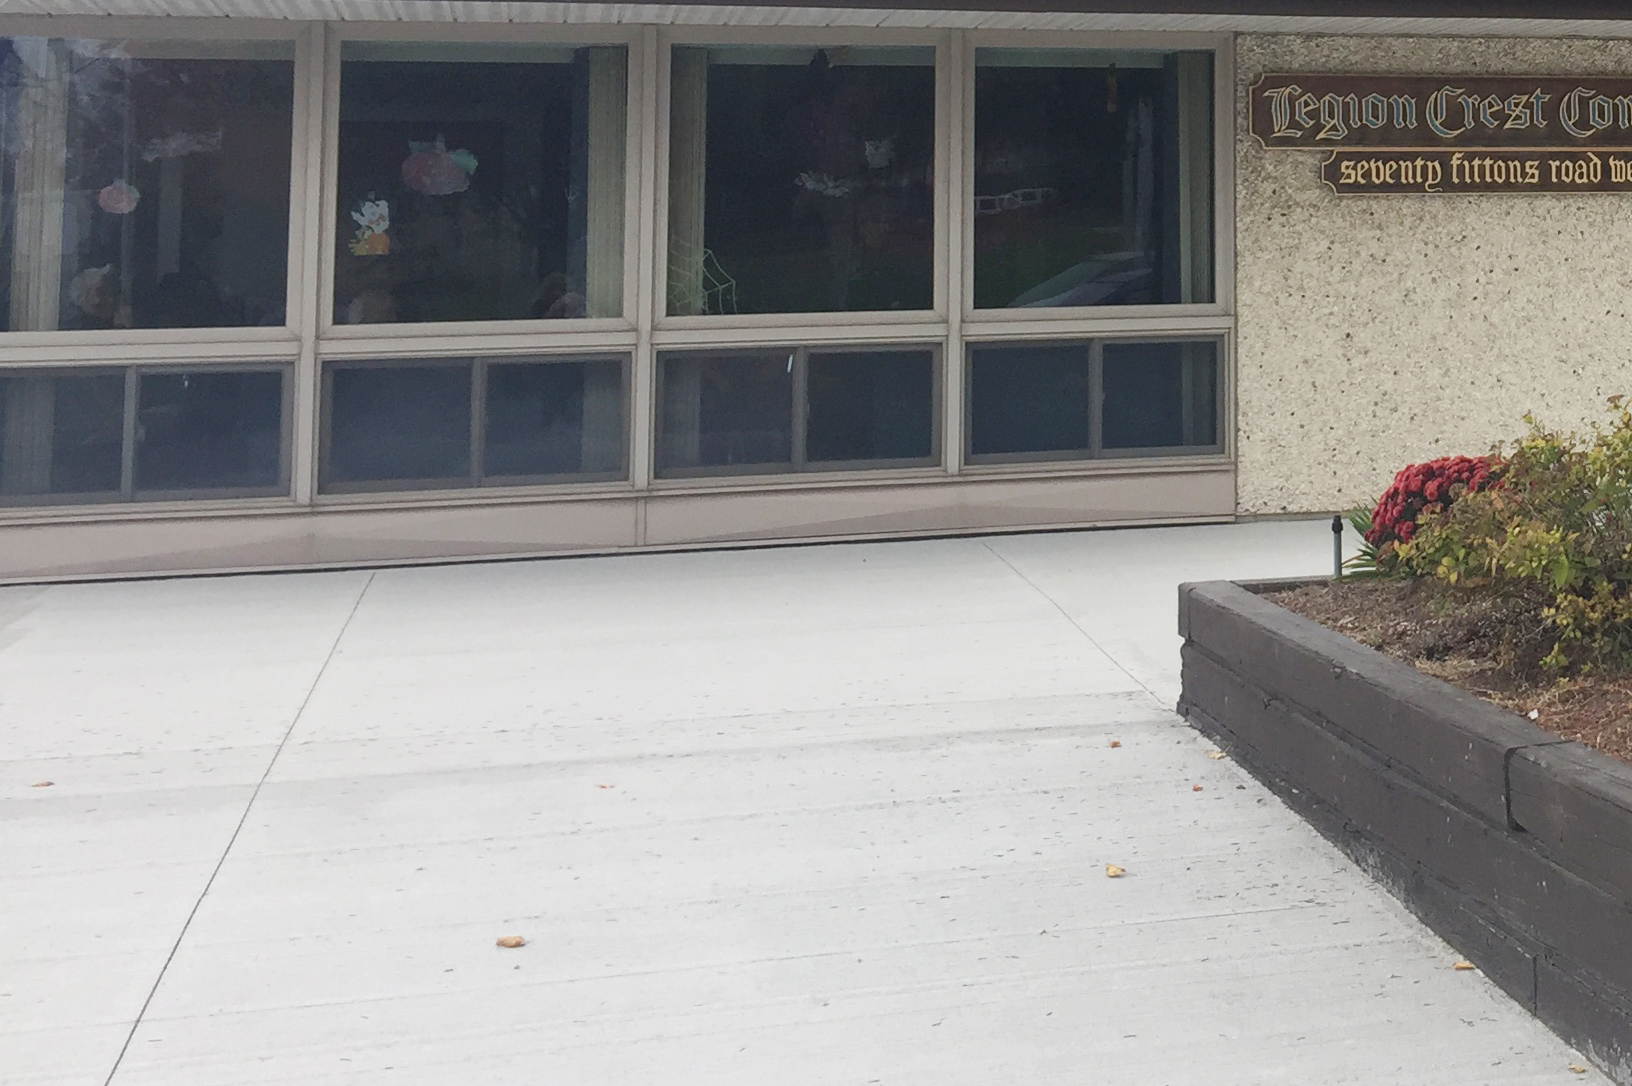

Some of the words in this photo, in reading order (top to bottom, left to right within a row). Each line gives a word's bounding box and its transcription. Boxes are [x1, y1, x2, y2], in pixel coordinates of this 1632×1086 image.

[1263, 85, 1417, 140] Legion
[1426, 85, 1551, 138] Crest
[1339, 156, 1443, 192] seventy
[1451, 152, 1540, 184] fittons
[1549, 152, 1602, 183] road
